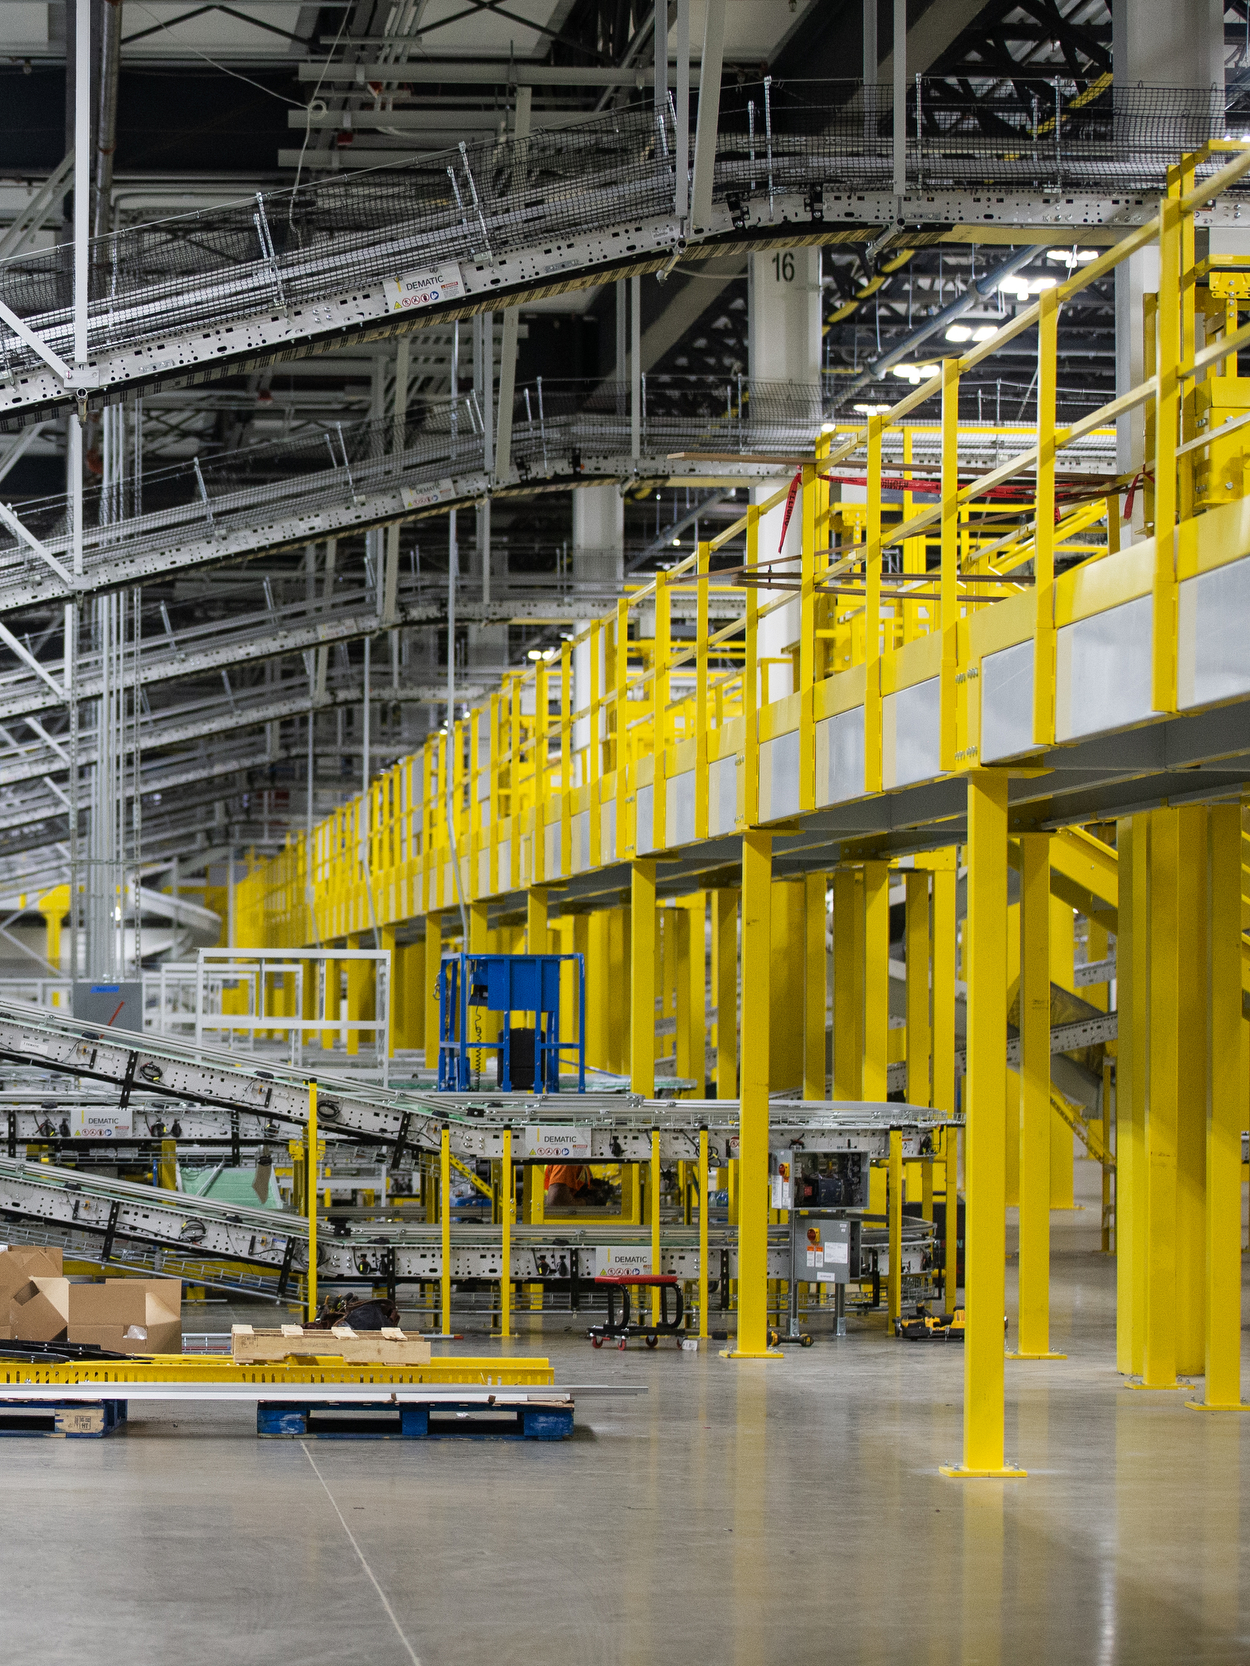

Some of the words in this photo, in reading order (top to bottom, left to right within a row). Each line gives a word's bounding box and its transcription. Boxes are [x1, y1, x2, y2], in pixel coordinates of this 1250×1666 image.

[772, 251, 795, 282] 16
[406, 275, 444, 291] DEMATIC
[88, 1117, 119, 1125] DEMATIC
[543, 1135, 577, 1143] DEMATIC
